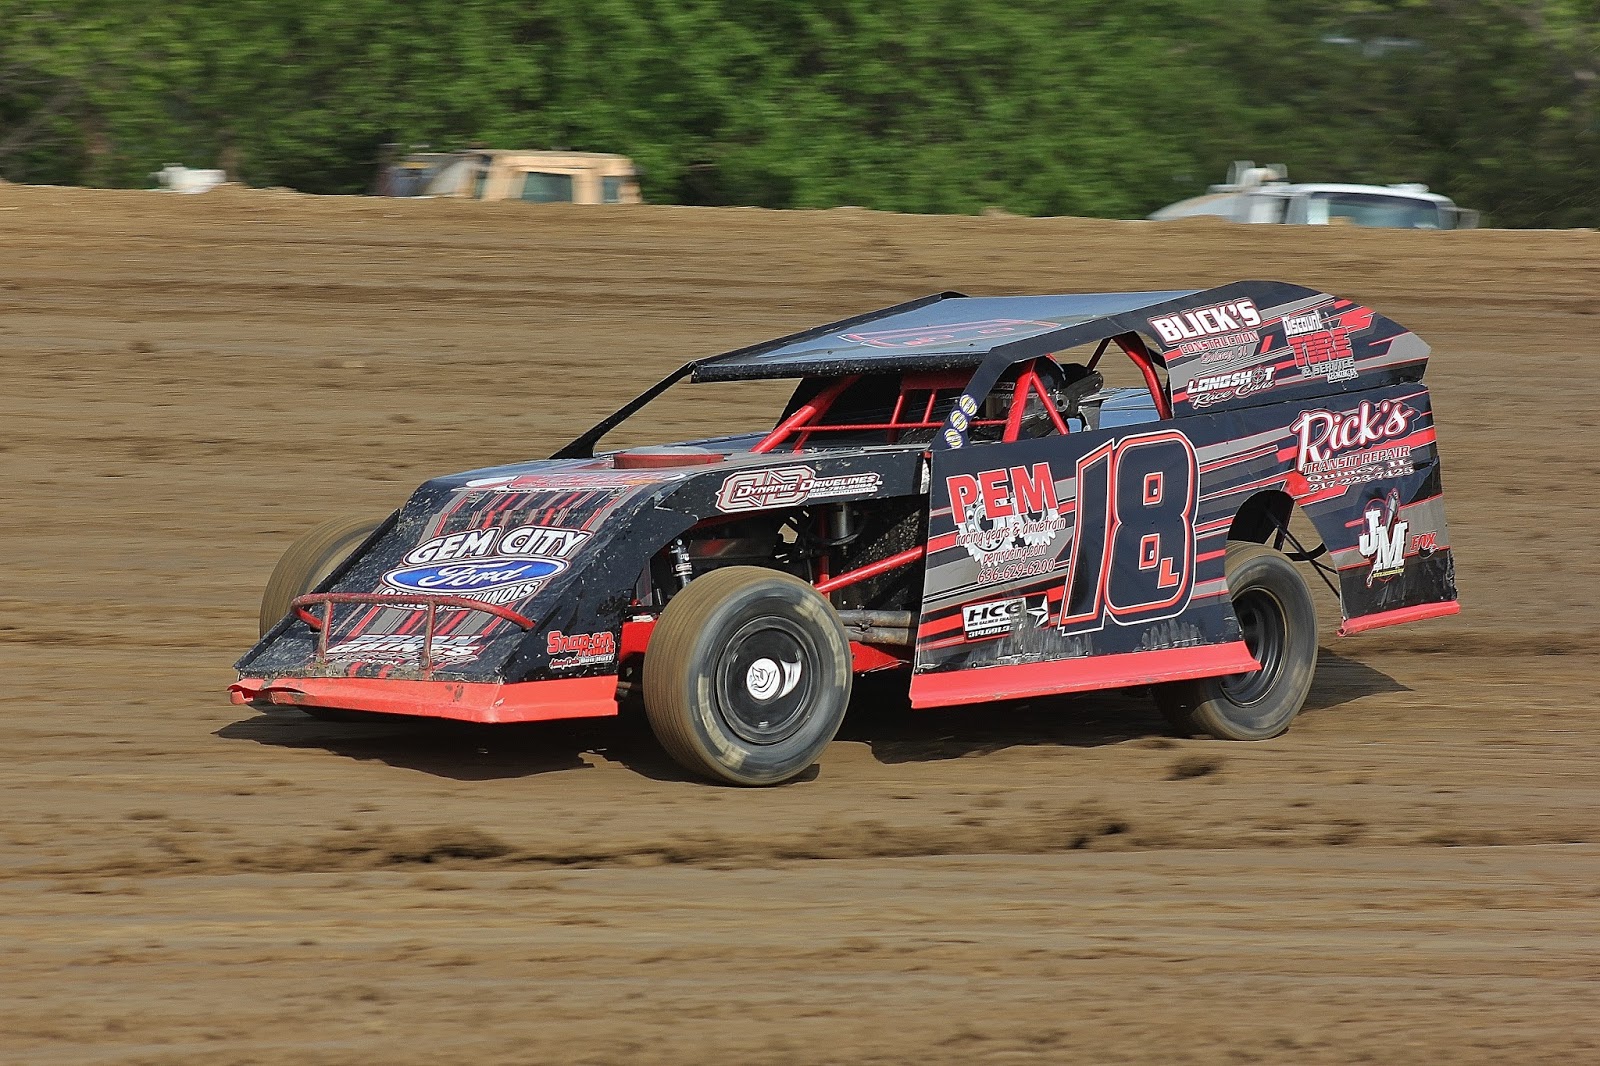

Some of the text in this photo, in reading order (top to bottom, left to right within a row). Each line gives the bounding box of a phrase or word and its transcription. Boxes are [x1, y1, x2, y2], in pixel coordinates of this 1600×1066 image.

[1151, 300, 1261, 343] BLICK'S
[1180, 331, 1260, 355] CONSTRUCTION
[1287, 326, 1354, 369] TIRE
[1186, 366, 1276, 395] LONGSHOT
[1188, 380, 1275, 409] Race Cars
[1290, 400, 1415, 473] Rick's
[1303, 446, 1411, 475] TRANSIT REPAIR
[737, 483, 797, 498] DYNAMIC
[800, 475, 877, 491] DRIVELINES
[946, 462, 1060, 524] PEM
[407, 527, 590, 564] GEM CITY
[955, 528, 984, 548] racing
[985, 526, 1011, 546] gears
[1022, 517, 1067, 535] drivetrain
[1058, 429, 1200, 636] 18
[417, 561, 533, 587] Ford
[978, 558, 1056, 584] 636-629-6200
[547, 631, 614, 656] Snap-on
